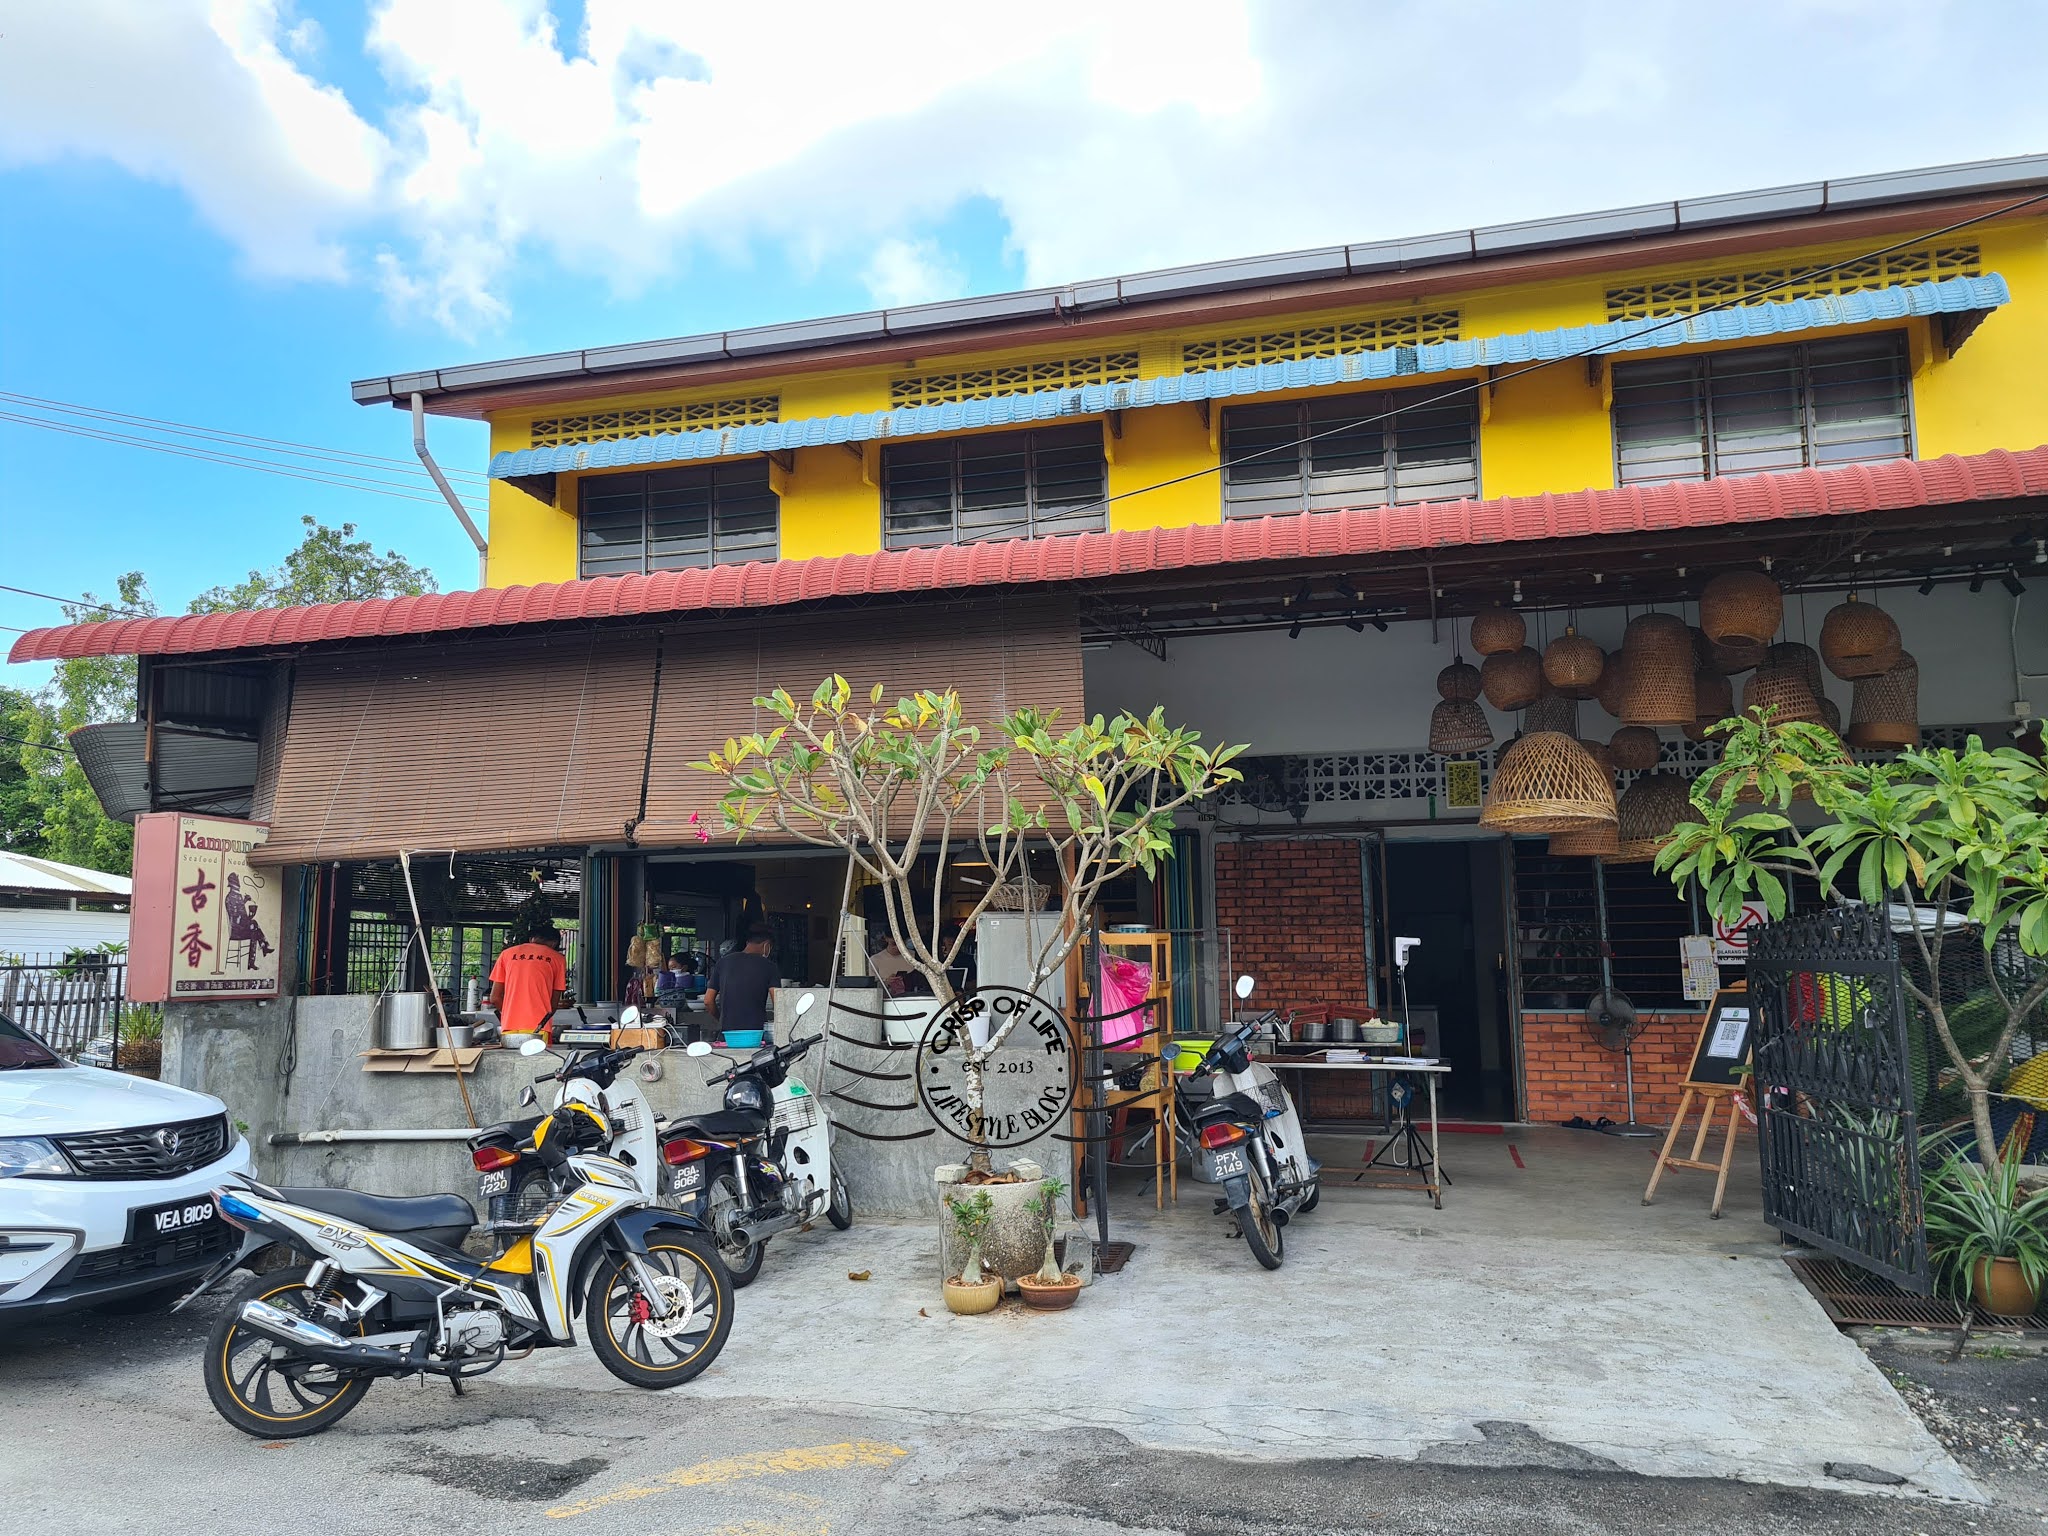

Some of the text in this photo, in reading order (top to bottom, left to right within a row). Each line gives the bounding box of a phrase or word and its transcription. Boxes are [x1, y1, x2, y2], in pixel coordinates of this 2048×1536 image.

[184, 855, 218, 864] Seafood
[180, 868, 215, 968] 古香
[1216, 1150, 1239, 1166] PFX
[484, 1169, 504, 1185] PKN
[1215, 1160, 1244, 1177] 2149
[480, 1179, 508, 1196] 7220
[579, 1189, 609, 1206] DEMAK
[155, 1209, 181, 1231] VEA
[183, 1202, 213, 1224] 8109
[331, 1241, 352, 1251] 110
